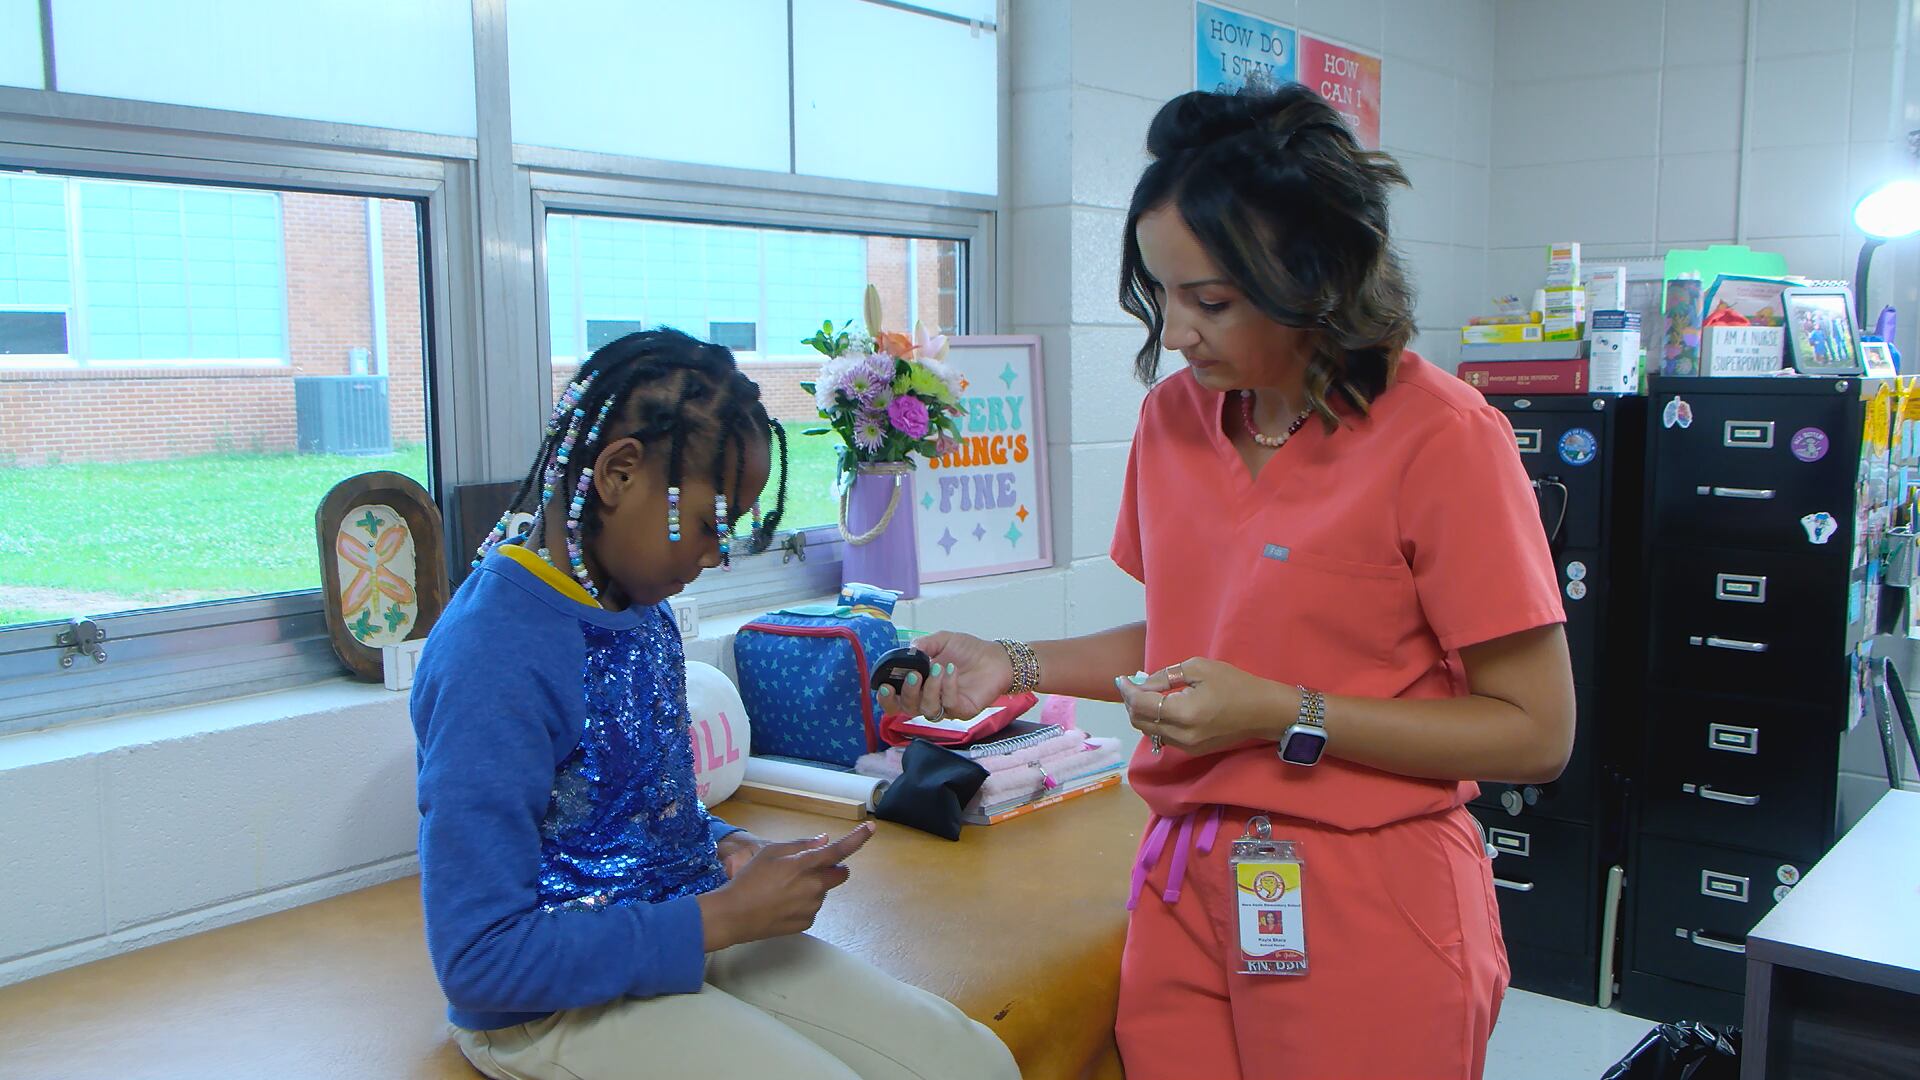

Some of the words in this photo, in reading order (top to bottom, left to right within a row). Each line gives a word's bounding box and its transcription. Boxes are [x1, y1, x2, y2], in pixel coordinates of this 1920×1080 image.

[1210, 19, 1254, 48] HOW
[1260, 32, 1284, 57] DO
[1220, 52, 1227, 72] I
[1232, 55, 1275, 80] STAY
[1323, 53, 1359, 80] HOW
[1320, 83, 1352, 105] CAN
[1355, 89, 1362, 109] I
[938, 471, 1017, 514] FINE
